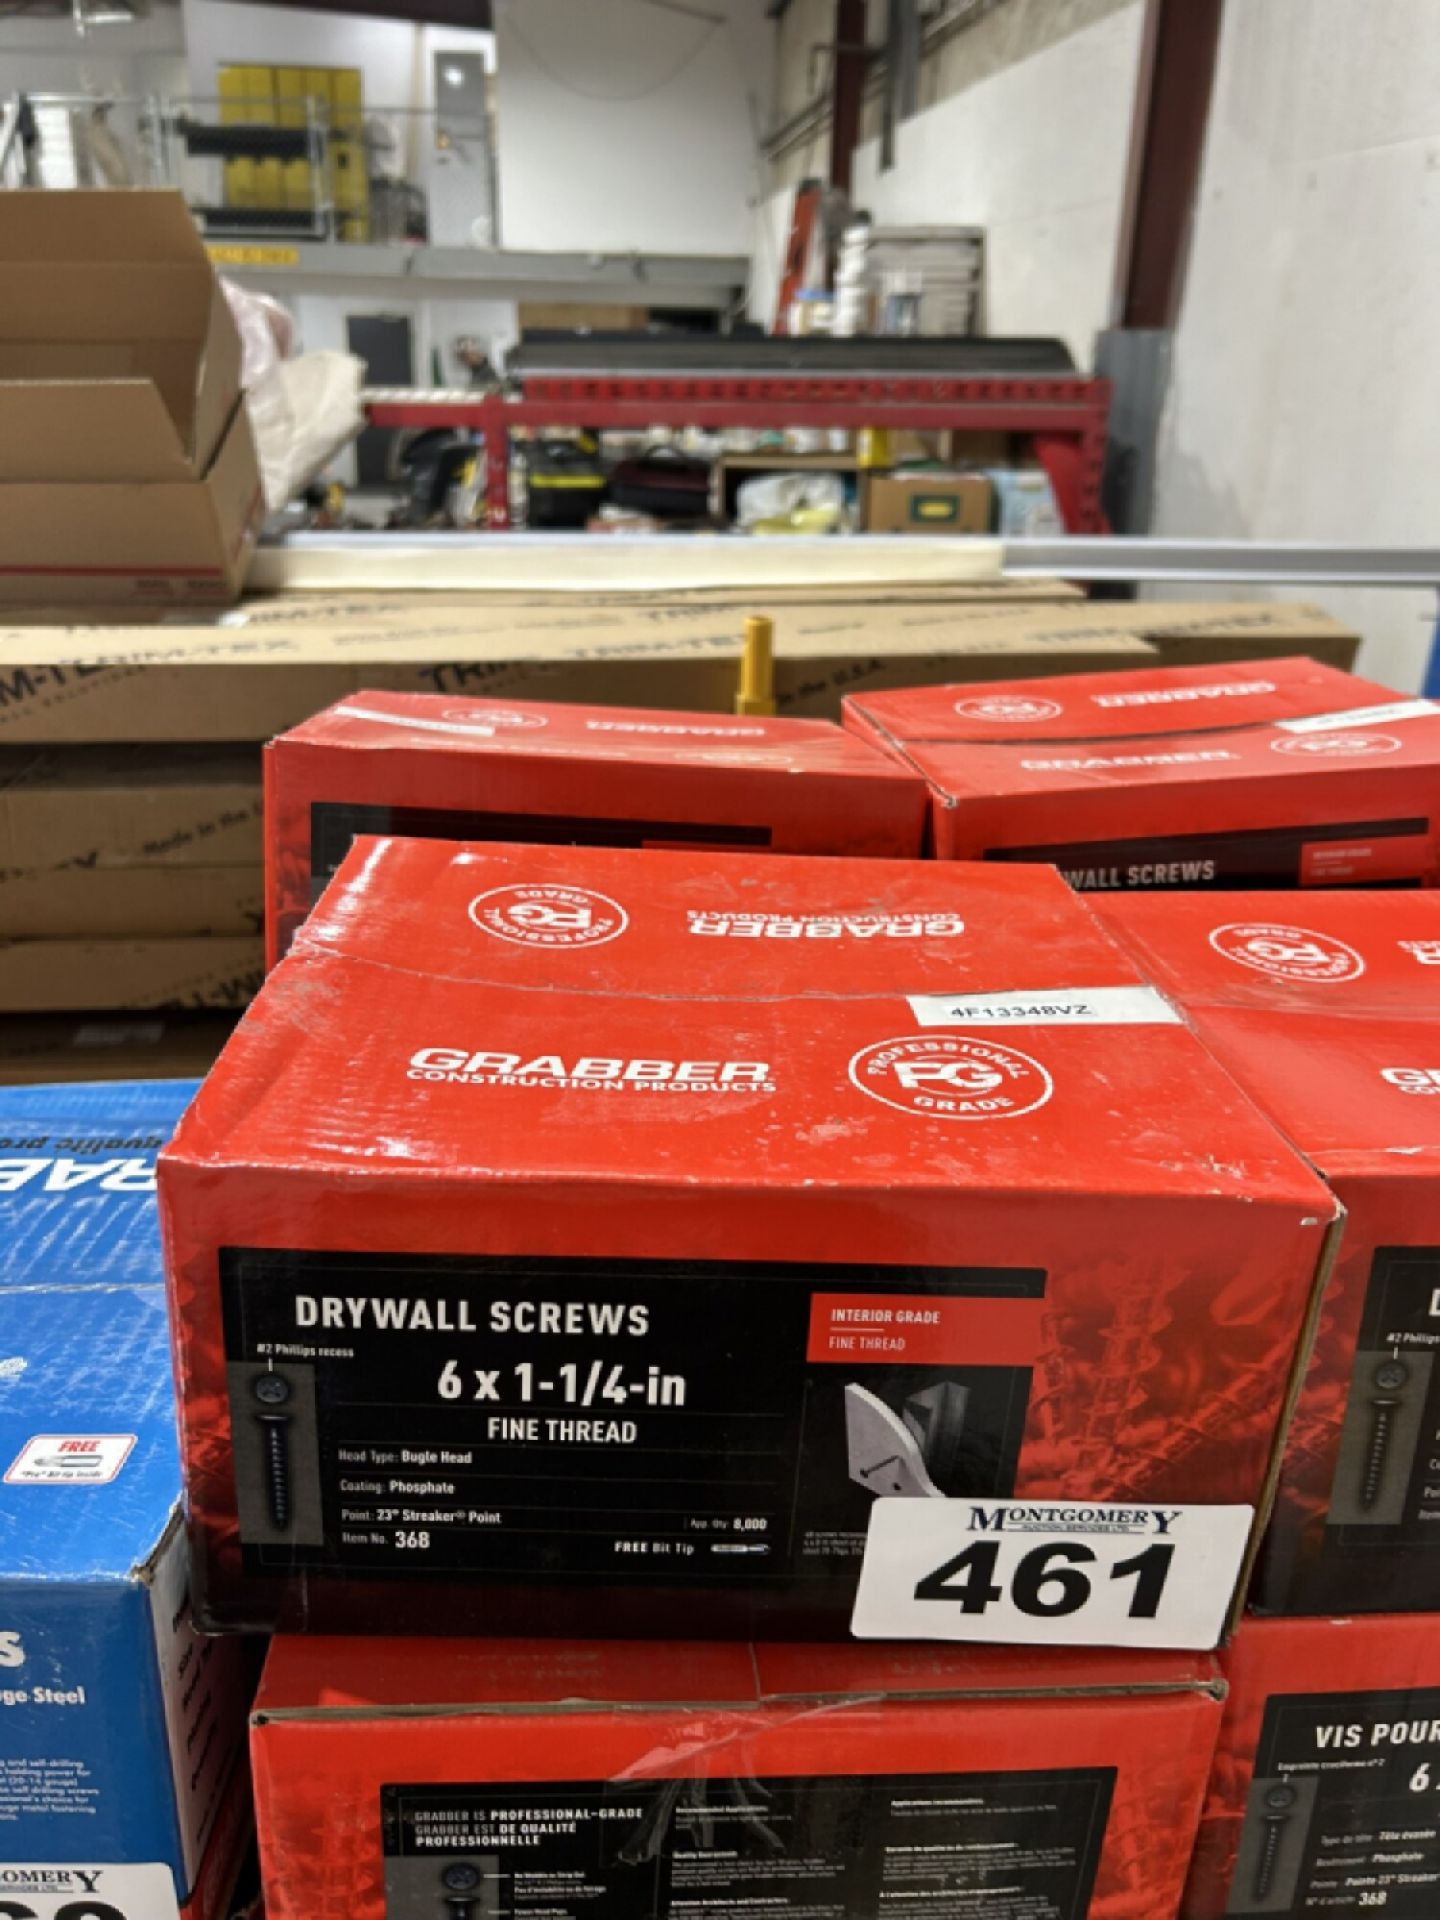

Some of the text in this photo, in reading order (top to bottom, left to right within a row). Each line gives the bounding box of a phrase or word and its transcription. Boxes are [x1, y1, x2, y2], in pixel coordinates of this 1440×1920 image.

[1127, 858, 1216, 885] SCREWS
[689, 917, 966, 938] GRABBER
[950, 1002, 1093, 1019] 4F13348VZ
[407, 1046, 771, 1083] GRABBER
[866, 1038, 1030, 1079] PROFESSIONAL
[406, 1068, 778, 1093] CONSTRUCTION PRODUCTS
[913, 1094, 1015, 1114] GRADE
[295, 1294, 650, 1337] DRYWALL SCREWS
[831, 1308, 941, 1325] INTERIOR GRADE
[275, 1342, 316, 1358] Phillips
[318, 1346, 354, 1358] recess
[828, 1335, 906, 1352] FINE THREAD
[437, 1358, 687, 1407] 6 x 1-1/4-in
[487, 1416, 638, 1444] FINE THREAD
[58, 1440, 102, 1453] FREE
[338, 1449, 367, 1463] Head
[402, 1449, 438, 1466] Bugle
[440, 1450, 473, 1464] Head
[388, 1479, 456, 1496] Phosphate
[468, 1510, 502, 1524] Point
[733, 1517, 769, 1532] 8,000
[967, 1506, 1183, 1535] MONTGOMERY
[341, 1531, 368, 1544] Item
[395, 1531, 431, 1550] 368
[614, 1540, 695, 1557] FREE Bit Tip
[913, 1539, 1176, 1619] 461
[33, 1686, 86, 1705] Steel
[1315, 1723, 1364, 1749] VIS
[1409, 1761, 1431, 1793] 6
[490, 1807, 643, 1821] PROFESSIONAL-GRADE
[499, 1822, 516, 1835] DE
[519, 1821, 577, 1834] QUALITÉ
[415, 1834, 541, 1848] PROFESSIONNELLE
[1358, 1890, 1388, 1907] 368
